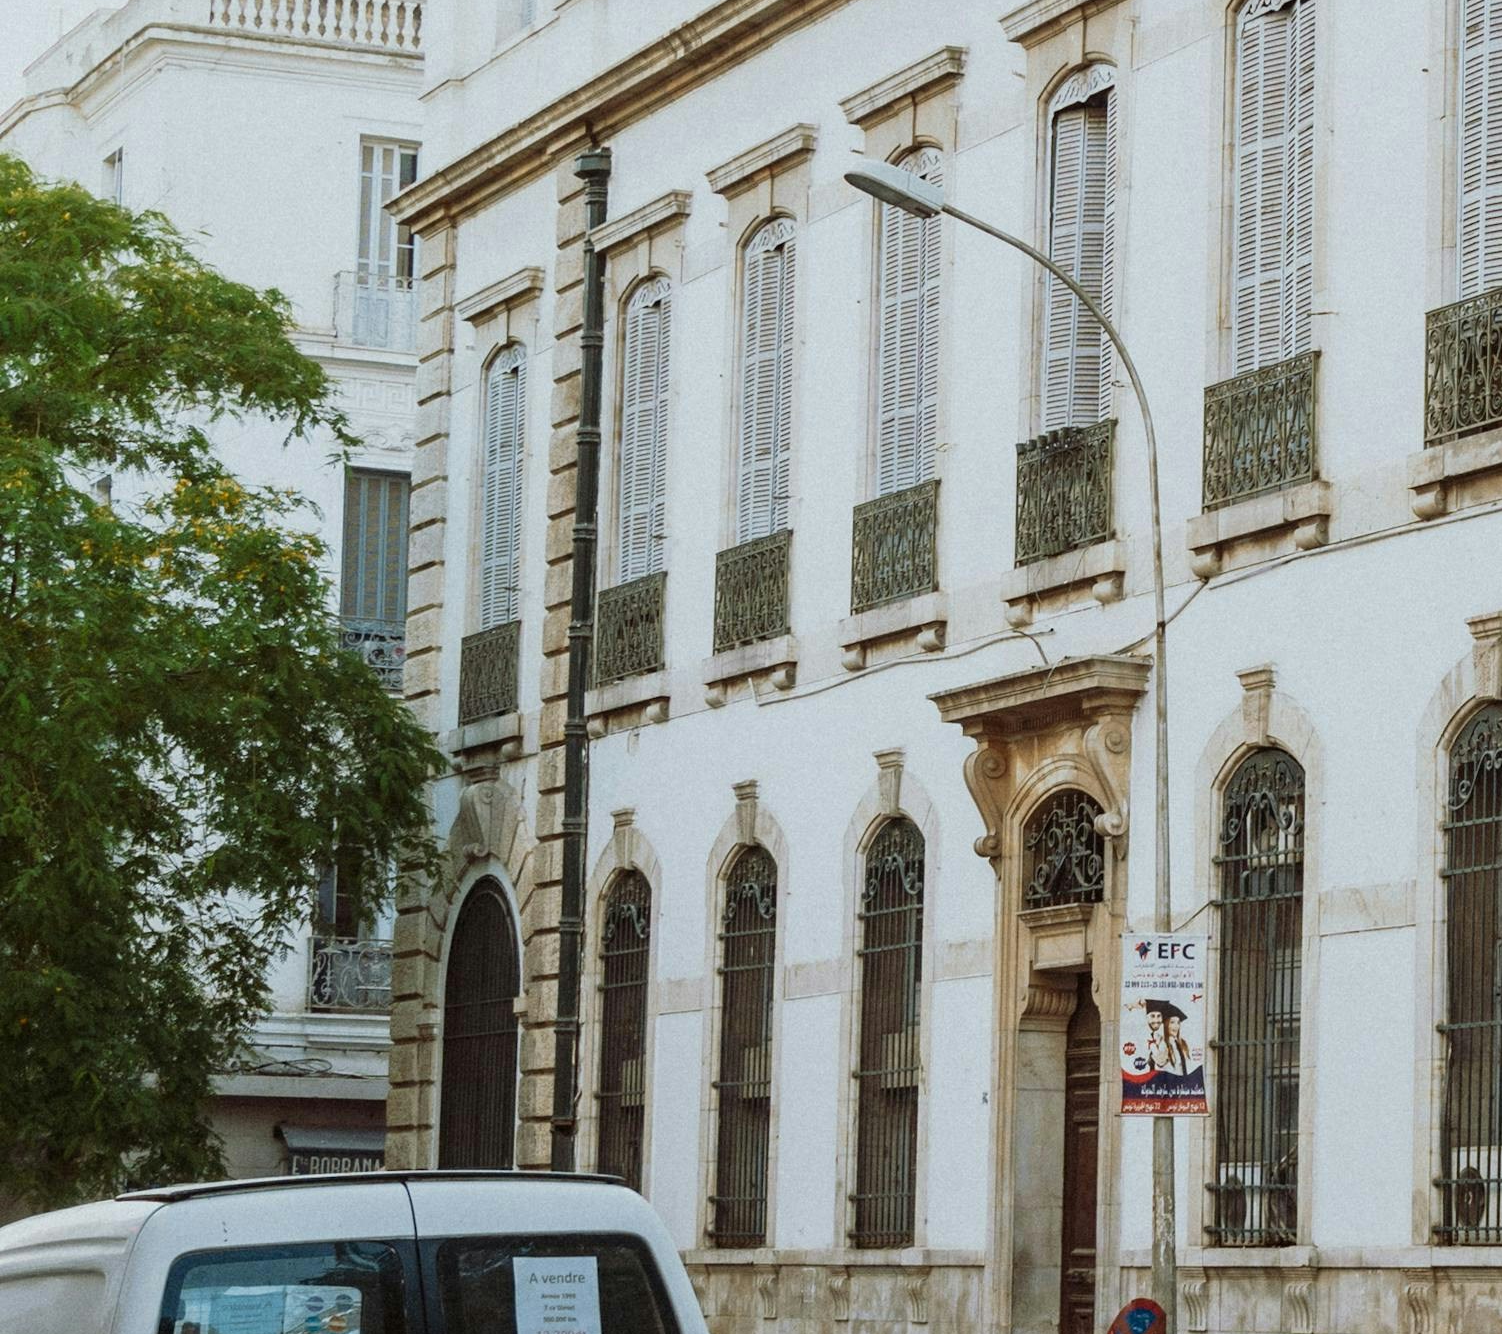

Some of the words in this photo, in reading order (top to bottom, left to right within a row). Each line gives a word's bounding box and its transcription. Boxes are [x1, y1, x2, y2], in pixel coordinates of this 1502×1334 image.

[1158, 943, 1195, 960] EFC
[529, 1272, 539, 1284] A
[541, 1272, 586, 1284] vendre
